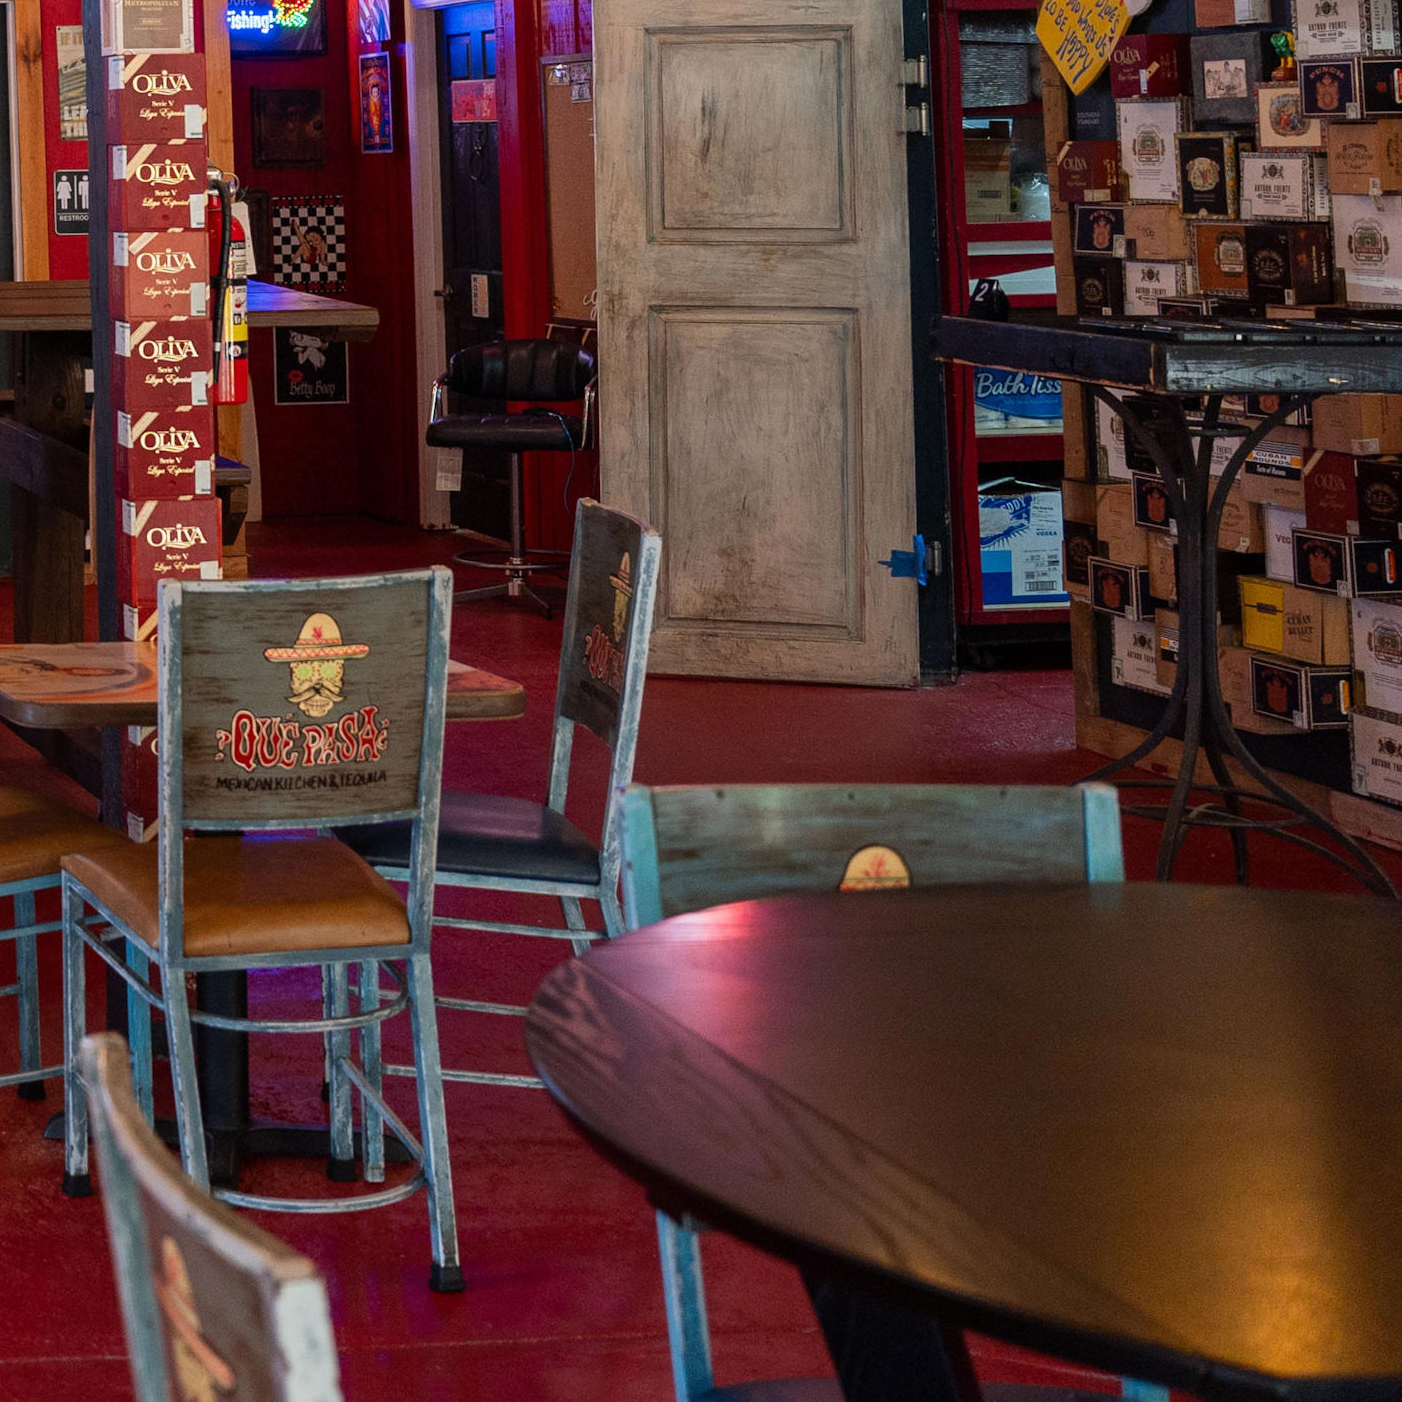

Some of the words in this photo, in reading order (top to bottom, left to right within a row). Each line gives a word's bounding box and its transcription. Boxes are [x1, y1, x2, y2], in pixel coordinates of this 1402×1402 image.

[132, 70, 193, 96] OLIVA
[136, 159, 196, 186] OLIVA
[59, 214, 90, 222] RESTROO
[136, 248, 196, 274] OLIVA
[974, 282, 989, 303] 2
[138, 336, 199, 363] OLIVA
[977, 372, 1028, 397] Bath
[140, 427, 201, 454] OLIVA
[146, 523, 208, 550] OLIVA
[216, 774, 272, 792] MEXICAN
[274, 773, 326, 790] KITCHEN
[340, 770, 387, 788] TEQUILA
